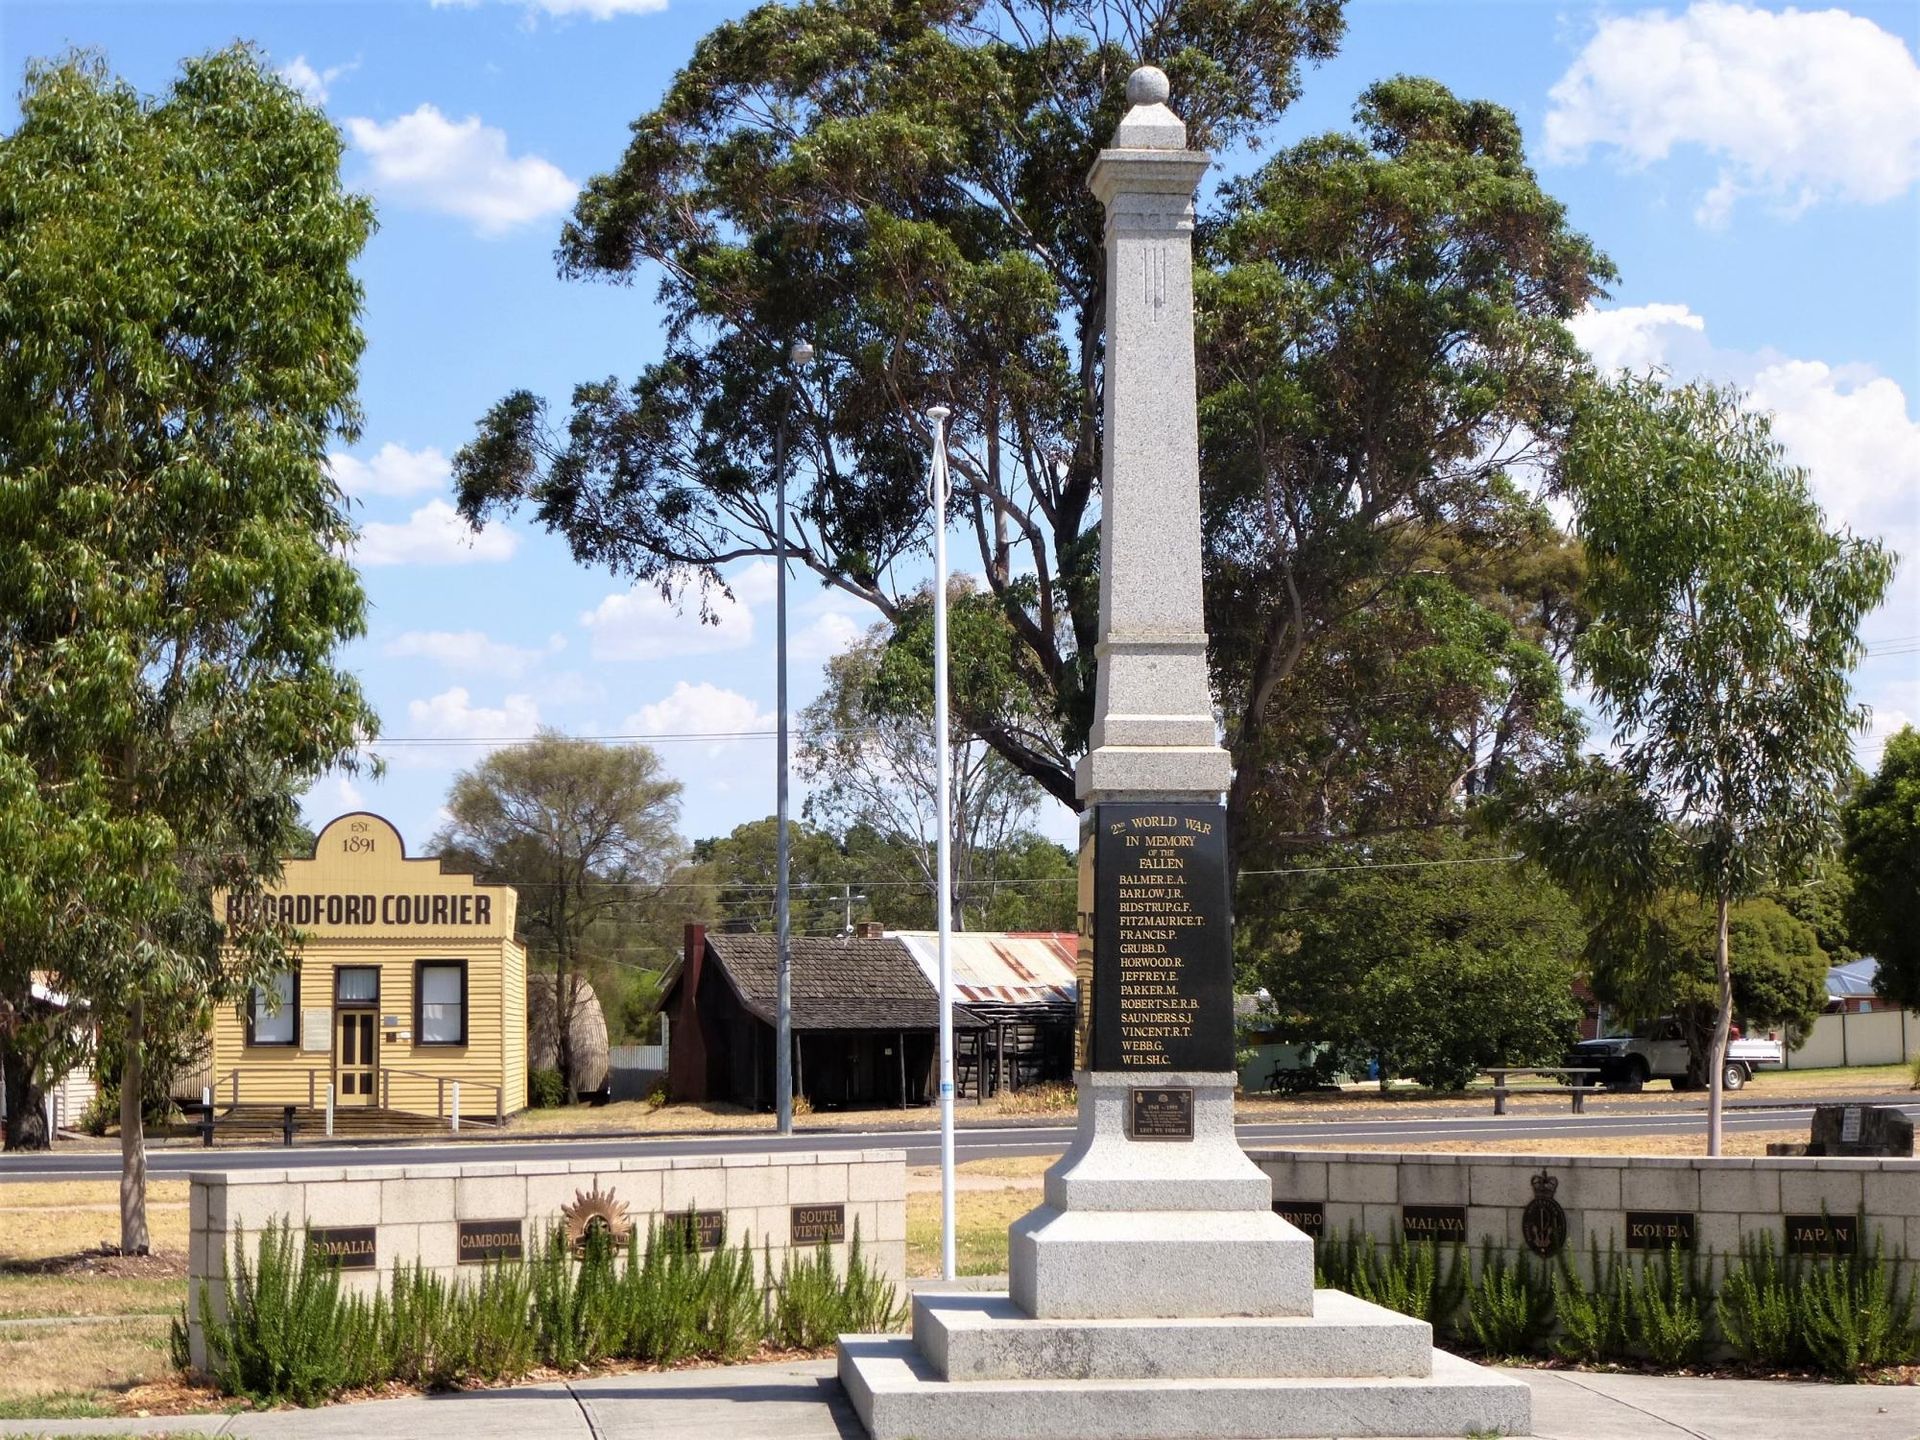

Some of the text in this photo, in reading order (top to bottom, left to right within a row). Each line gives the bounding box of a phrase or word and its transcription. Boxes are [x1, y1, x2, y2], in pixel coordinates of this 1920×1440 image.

[1131, 816, 1177, 828] WORLD
[1184, 818, 1211, 835] WAR
[343, 836, 375, 854] 1891
[1126, 836, 1196, 846] IN MEMORY
[1148, 849, 1175, 857] OF THE
[1139, 858, 1184, 869] FALLEN
[382, 894, 491, 925] COURIER
[799, 1210, 837, 1224] SOUTH
[1404, 1217, 1465, 1230] MALAYA
[794, 1223, 844, 1238] VIETNAM
[1794, 1228, 1848, 1241] JAPN
[461, 1232, 521, 1248] CAMBODIA
[311, 1240, 376, 1256] SOMALIA
